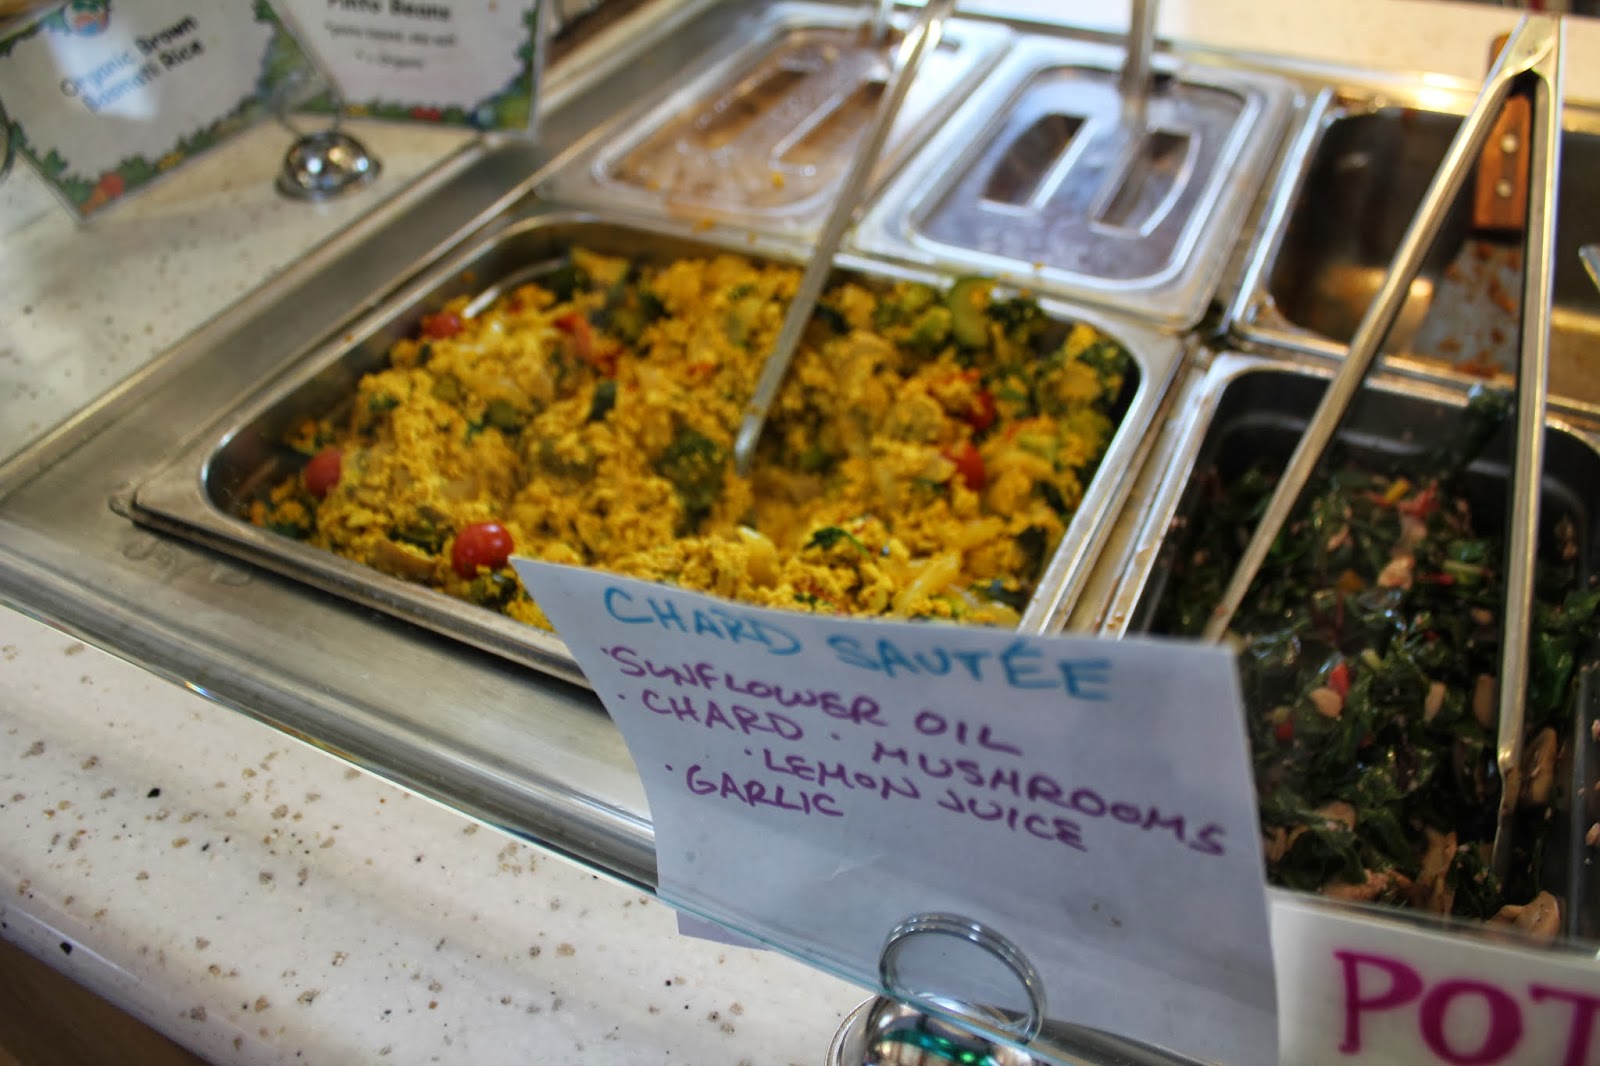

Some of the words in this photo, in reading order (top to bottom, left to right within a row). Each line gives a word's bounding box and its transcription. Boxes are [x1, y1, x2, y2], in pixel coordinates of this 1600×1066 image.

[135, 15, 198, 56] Brown
[157, 40, 204, 71] Rice
[603, 585, 803, 656] CHARD
[608, 645, 889, 728] SUNFLOWER
[914, 710, 1023, 757] OIL
[641, 689, 804, 741] CHARD
[871, 740, 1226, 857] MUSHROOMS
[686, 764, 844, 818] GARLIC
[763, 748, 921, 801] LEMON
[936, 788, 1088, 853] JUICE
